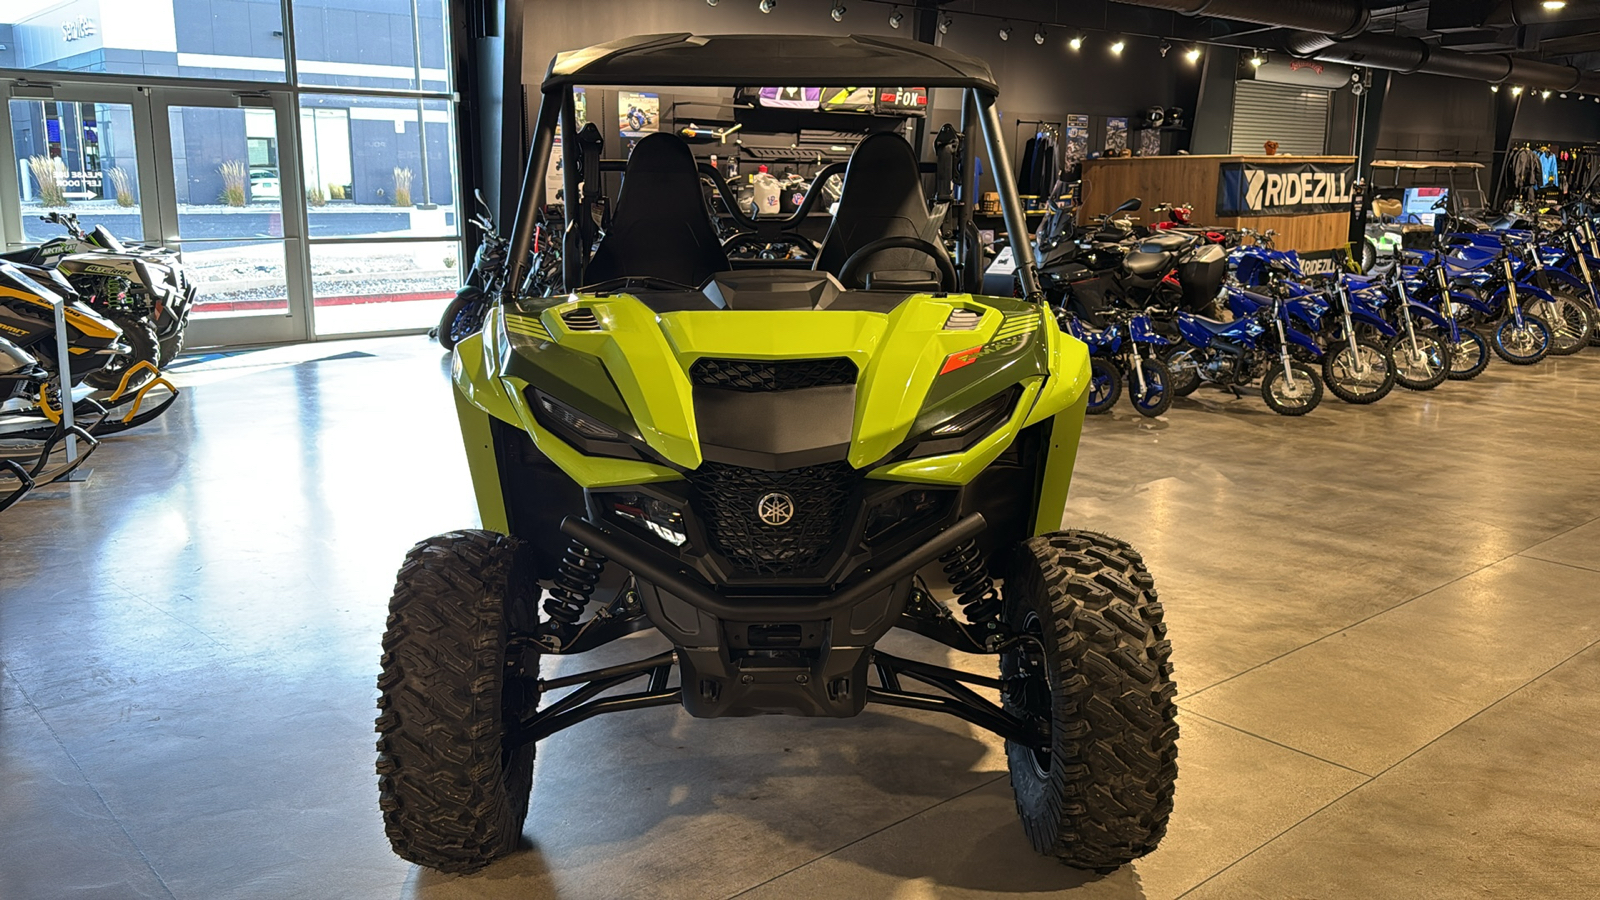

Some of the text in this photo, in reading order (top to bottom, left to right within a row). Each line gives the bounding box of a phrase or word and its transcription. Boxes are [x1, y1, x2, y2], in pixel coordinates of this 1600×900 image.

[895, 92, 918, 106] FOX
[42, 243, 77, 255] ARCTIC CAT
[87, 266, 133, 276] ALTERRA
[1305, 258, 1337, 275] RIDEZILL
